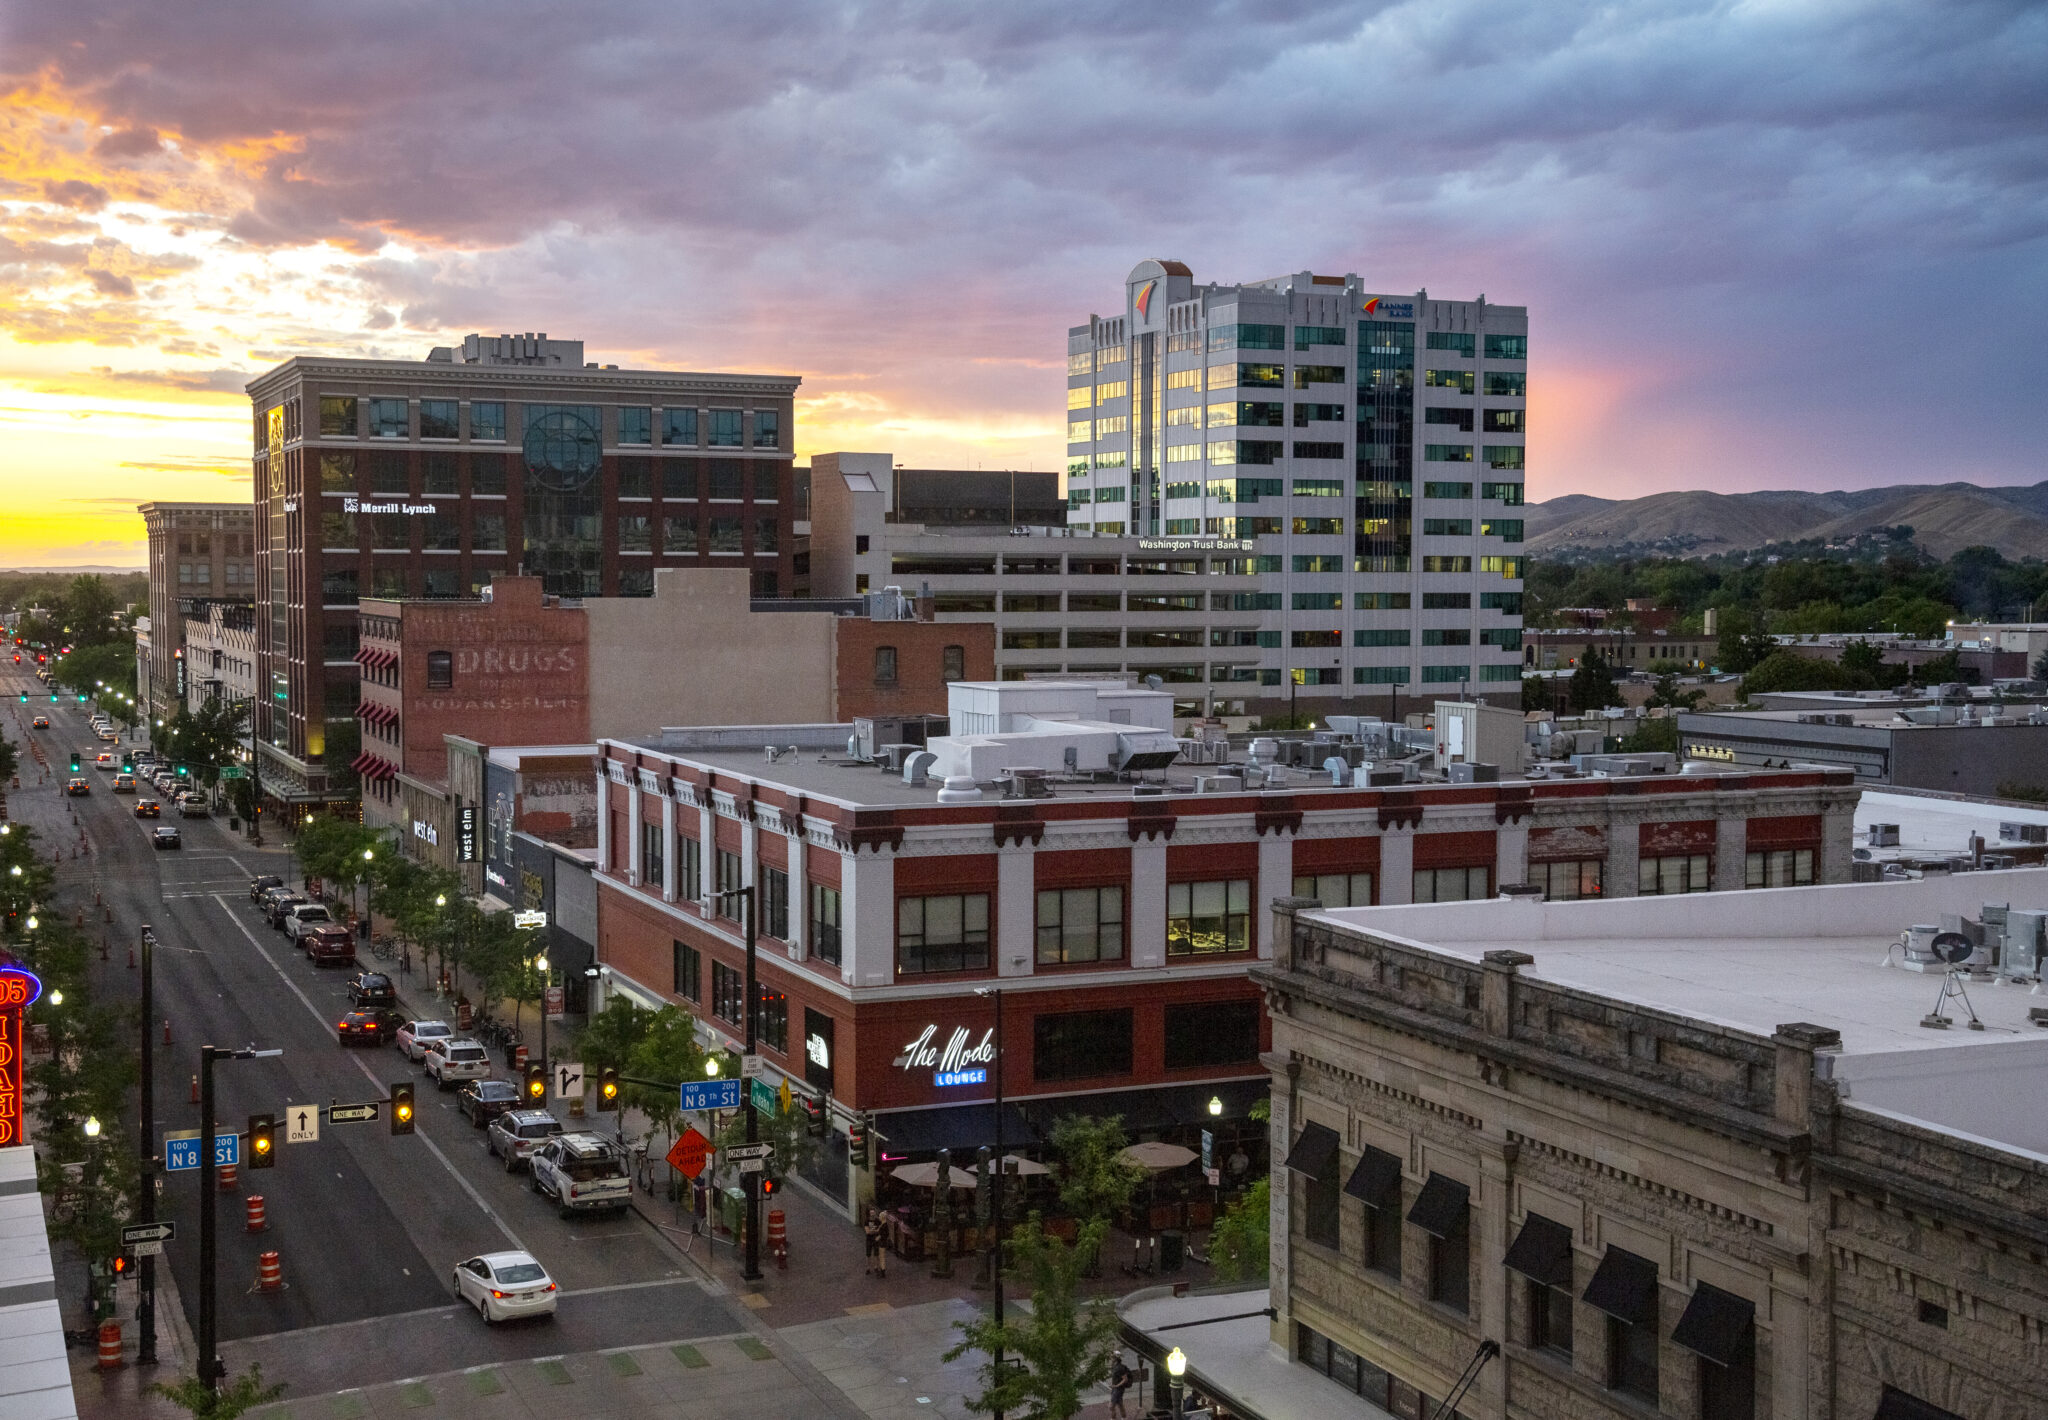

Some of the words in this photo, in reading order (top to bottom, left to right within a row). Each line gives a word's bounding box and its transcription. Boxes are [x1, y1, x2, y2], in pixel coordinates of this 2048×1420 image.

[1378, 302, 1414, 310] BANNER
[1389, 310, 1414, 318] BANK
[360, 503, 399, 514] Merrill
[402, 503, 436, 515] Lynch
[1139, 540, 1191, 552] Washington
[1192, 540, 1214, 549] Trust
[1216, 540, 1239, 550] Bank
[458, 647, 577, 674] DRUGS
[462, 809, 472, 830] elm
[462, 834, 472, 860] west
[904, 1024, 937, 1072] The
[939, 1025, 994, 1073] Mode
[938, 1071, 984, 1086] LOUNGE
[686, 1085, 699, 1093] 100
[721, 1082, 736, 1090] 200
[685, 1095, 694, 1107] N
[721, 1091, 735, 1105] St
[334, 1111, 348, 1119] ONE
[351, 1109, 364, 1117] WAY
[291, 1131, 314, 1140] ONLY
[173, 1142, 188, 1151] 100
[216, 1138, 233, 1147] 200
[676, 1143, 706, 1156] DETOUR
[172, 1153, 183, 1167] N
[216, 1148, 233, 1162] St
[729, 1149, 744, 1158] ONE
[746, 1147, 761, 1156] WAY
[679, 1155, 706, 1166] AHEAD
[127, 1231, 142, 1239] ONE
[145, 1229, 160, 1237] WAY
